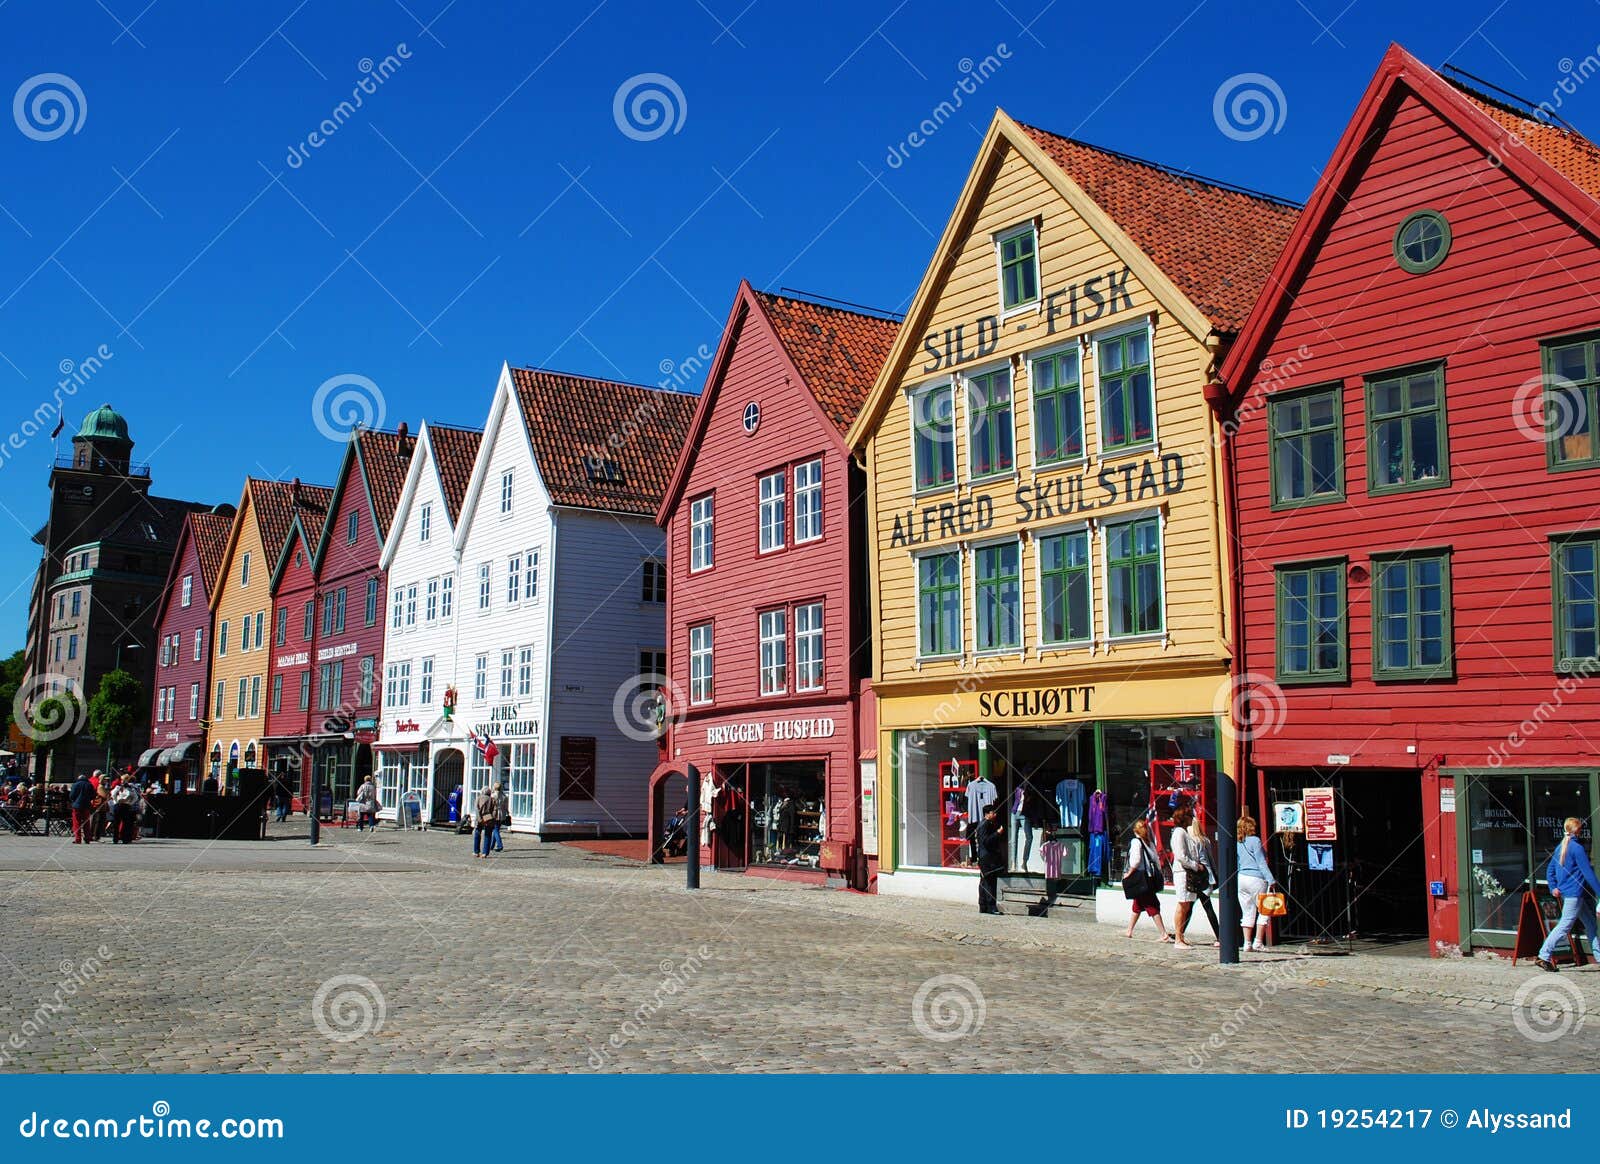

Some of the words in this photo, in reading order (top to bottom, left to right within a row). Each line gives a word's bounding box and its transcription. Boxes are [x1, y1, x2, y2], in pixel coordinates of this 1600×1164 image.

[922, 314, 999, 374] SILD
[1046, 265, 1134, 336] FISK
[890, 494, 994, 549] ALFRED
[1016, 453, 1184, 523] SKULSTAD
[979, 686, 1096, 717] SCHJØTT
[504, 720, 540, 736] GALLERY
[706, 722, 766, 745] BRYGGEN
[773, 718, 836, 740] HUSFLID
